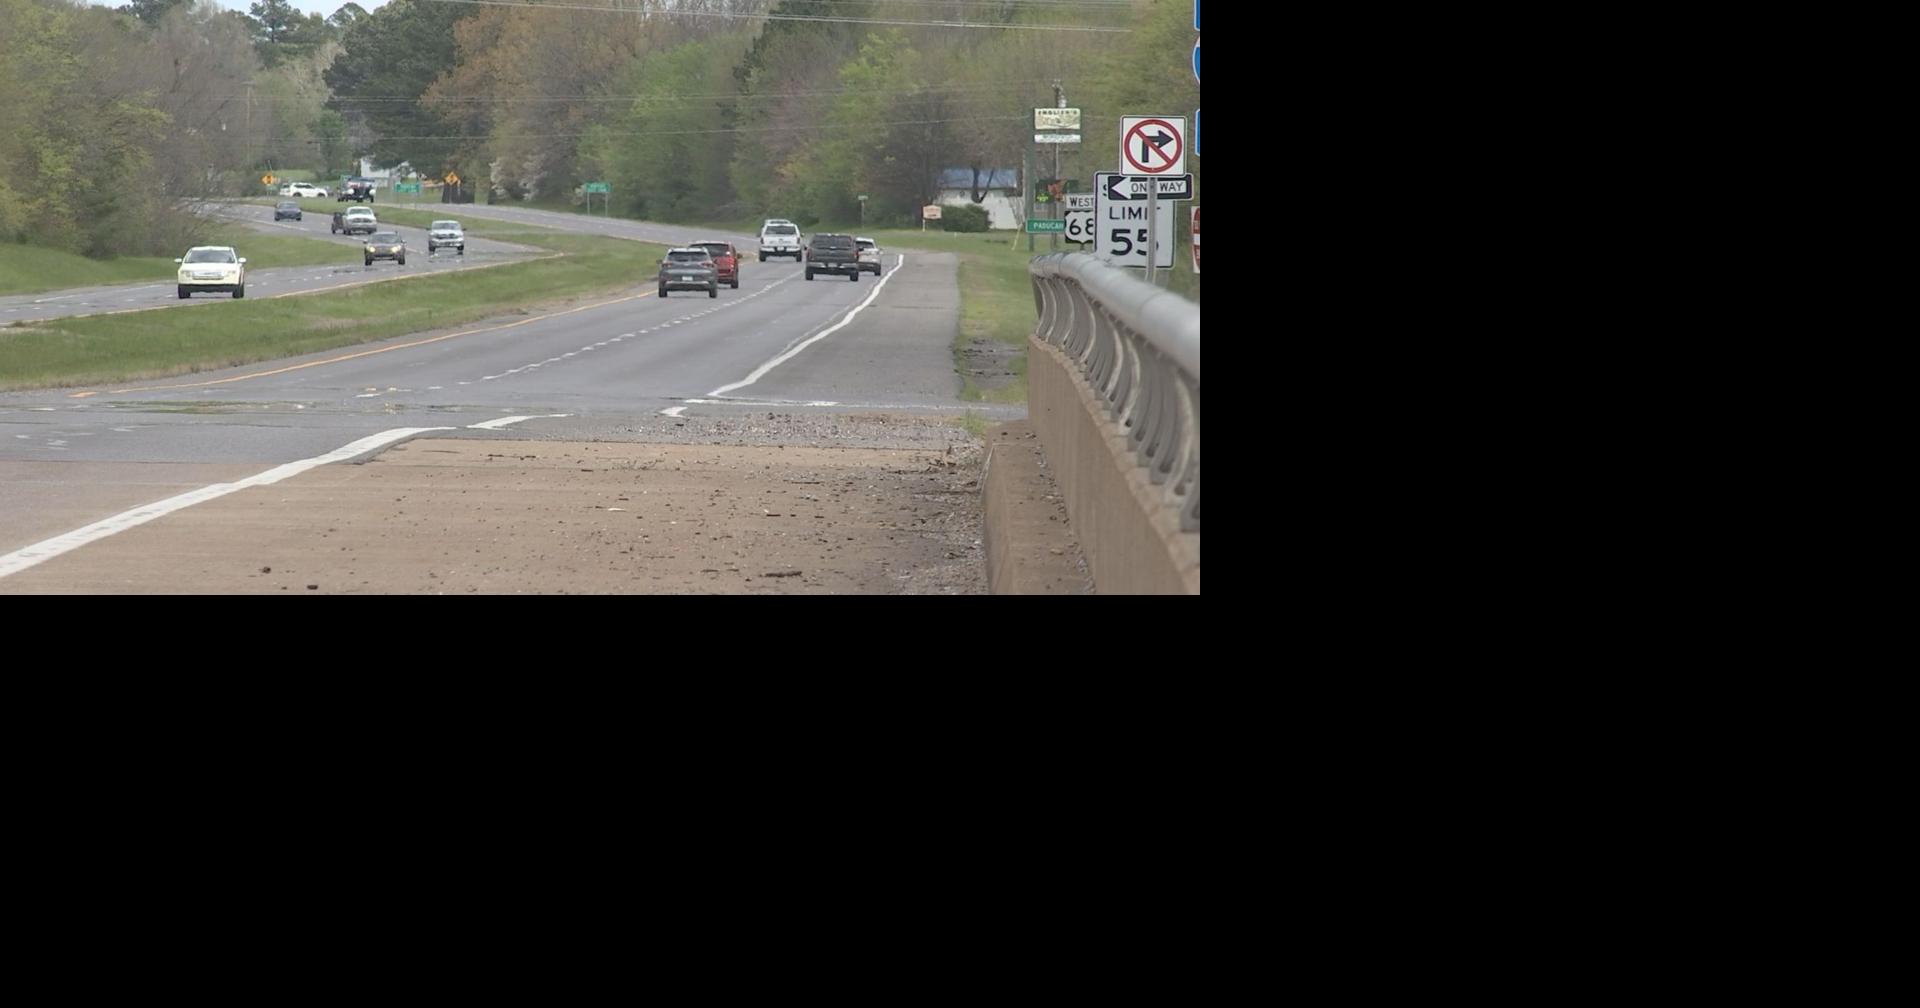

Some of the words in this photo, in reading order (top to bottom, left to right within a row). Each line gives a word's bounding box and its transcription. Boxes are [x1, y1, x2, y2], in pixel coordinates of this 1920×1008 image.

[1131, 182, 1155, 193] ON
[1159, 182, 1184, 192] WAY
[1109, 206, 1161, 220] LIMI
